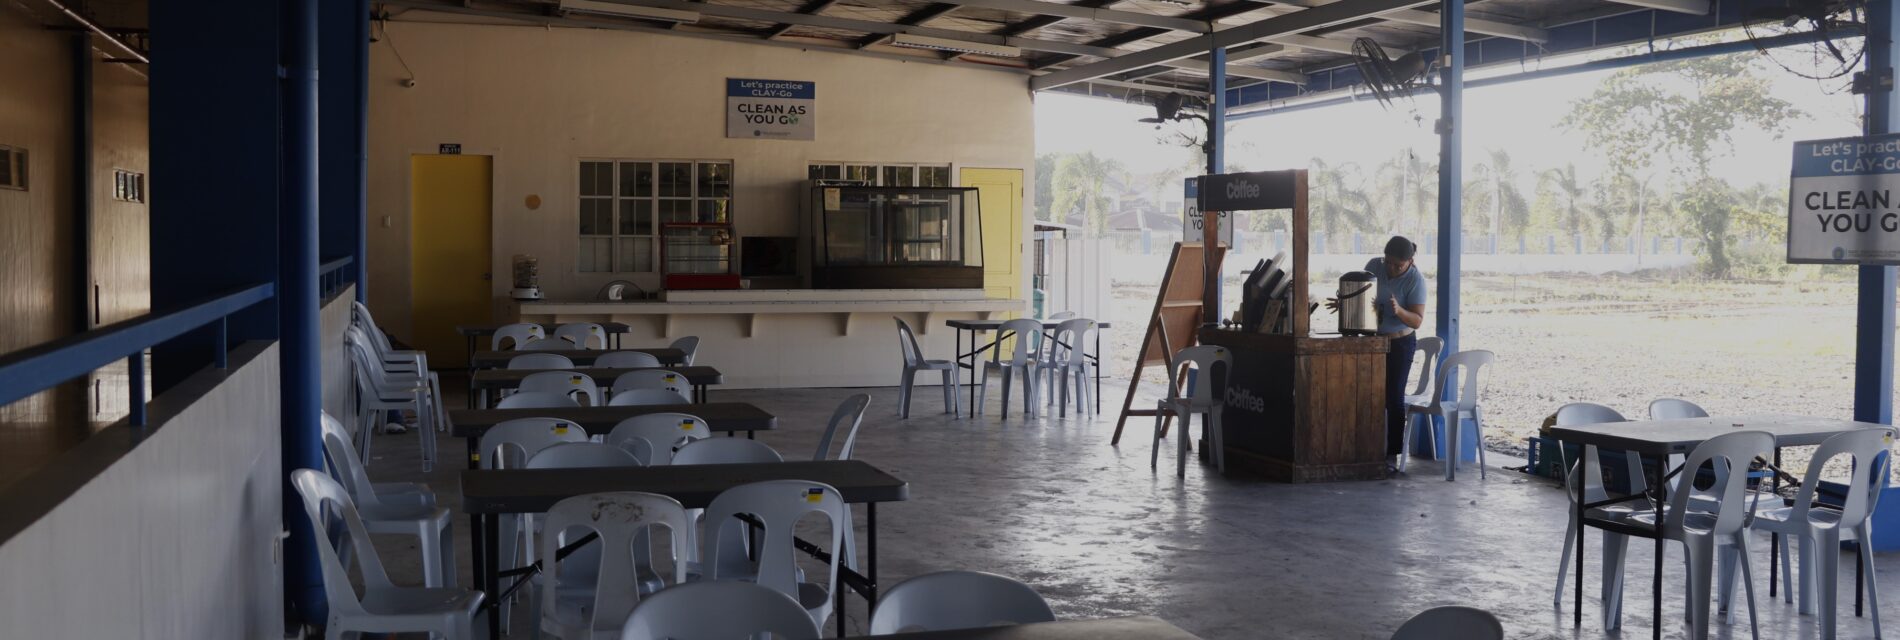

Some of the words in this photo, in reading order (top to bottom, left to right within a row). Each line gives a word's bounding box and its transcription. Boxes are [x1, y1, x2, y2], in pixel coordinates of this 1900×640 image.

[741, 80, 763, 88] Let's
[765, 81, 803, 91] practice
[752, 89, 792, 97] CLAY-Go
[737, 103, 784, 114] CLEAN
[787, 105, 806, 115] AS
[745, 114, 775, 125] YOU
[1812, 142, 1852, 157] Let's
[1856, 140, 1900, 157] pract
[1226, 178, 1260, 200] Coffee
[1805, 190, 1890, 211] CLEAN
[1192, 219, 1204, 230] YO
[1817, 213, 1872, 233] YOU
[1880, 213, 1900, 233] G
[1226, 384, 1265, 413] Coffee
